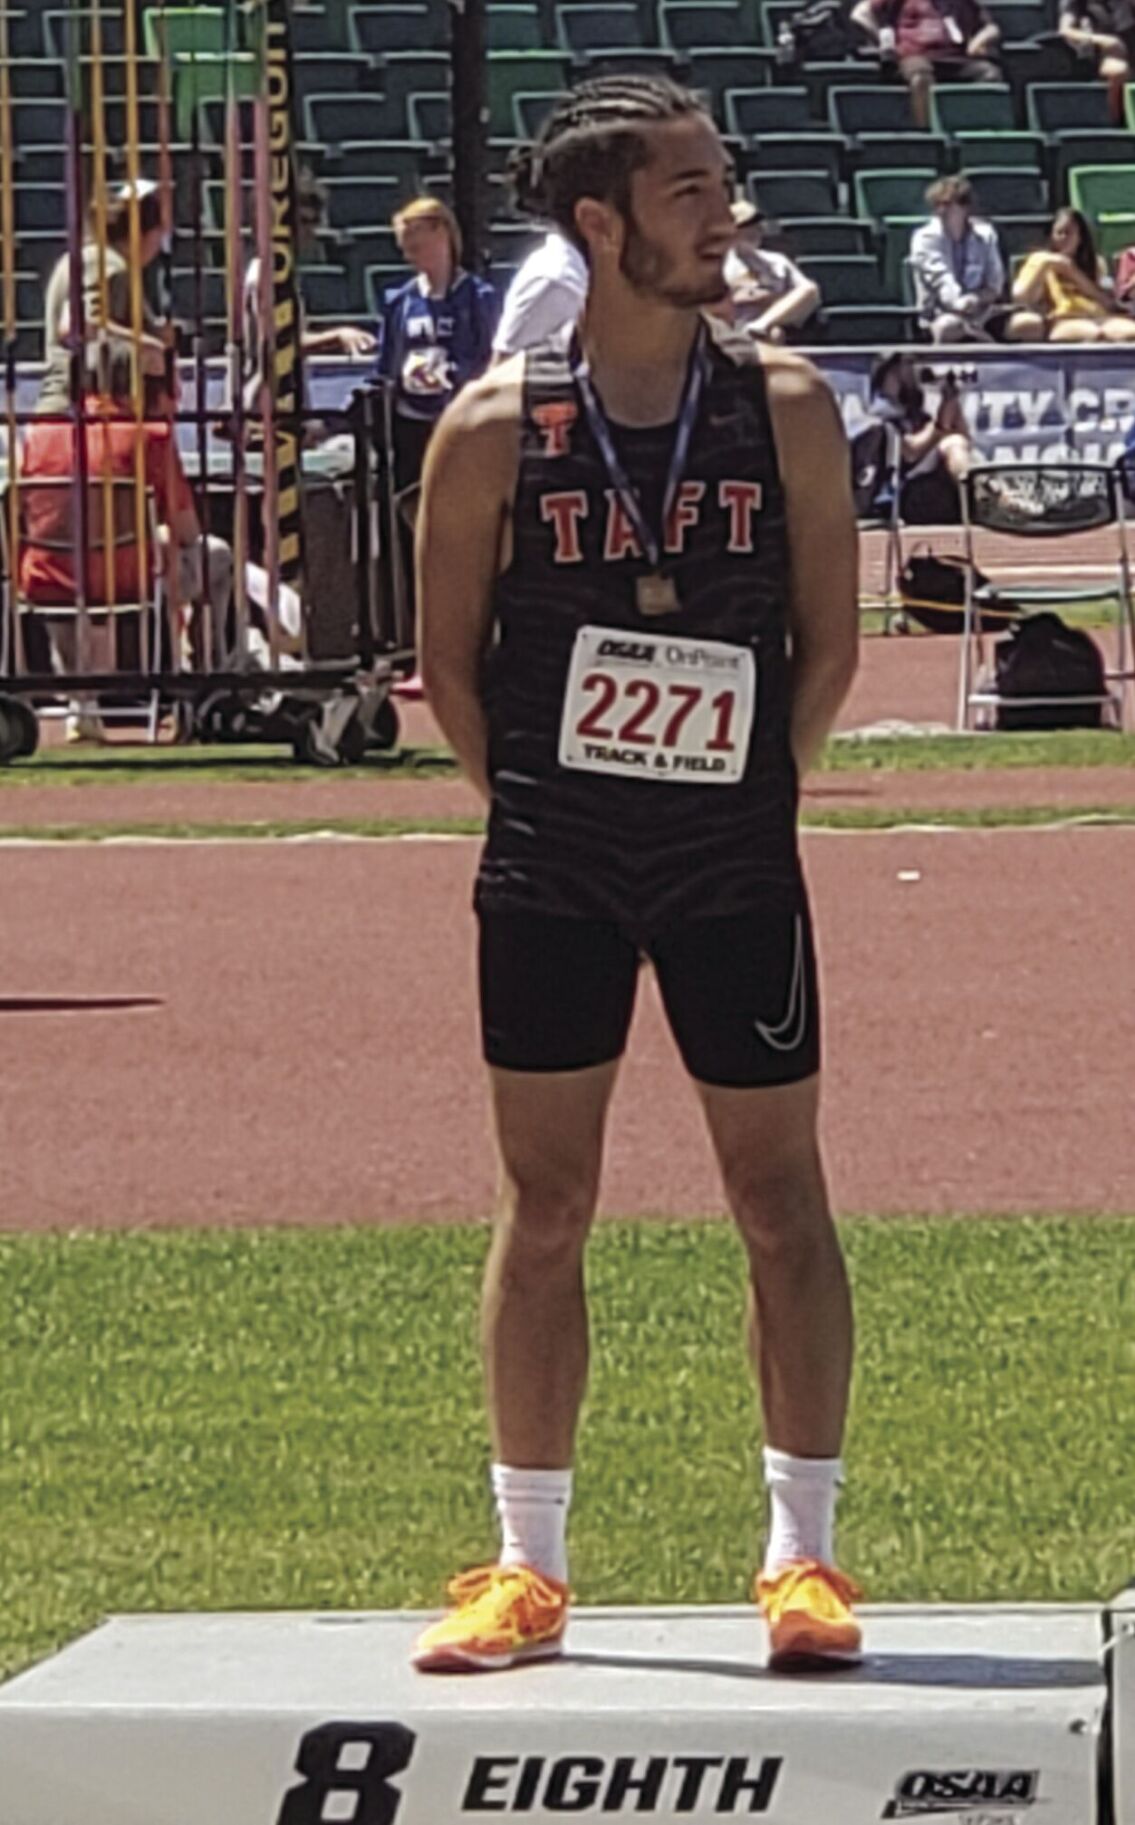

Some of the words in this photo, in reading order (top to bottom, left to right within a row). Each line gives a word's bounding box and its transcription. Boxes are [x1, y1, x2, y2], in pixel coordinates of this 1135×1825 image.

[264, 22, 291, 283] OREGON
[540, 480, 762, 563] TAFT
[597, 639, 656, 663] OSAA
[576, 673, 736, 751] 2271
[583, 743, 647, 767] TRACK
[654, 752, 668, 769] &
[673, 755, 726, 772] FIELD
[275, 1721, 417, 1825] 8
[461, 1756, 784, 1813] EIGHTH
[897, 1768, 1038, 1803] OSAA
